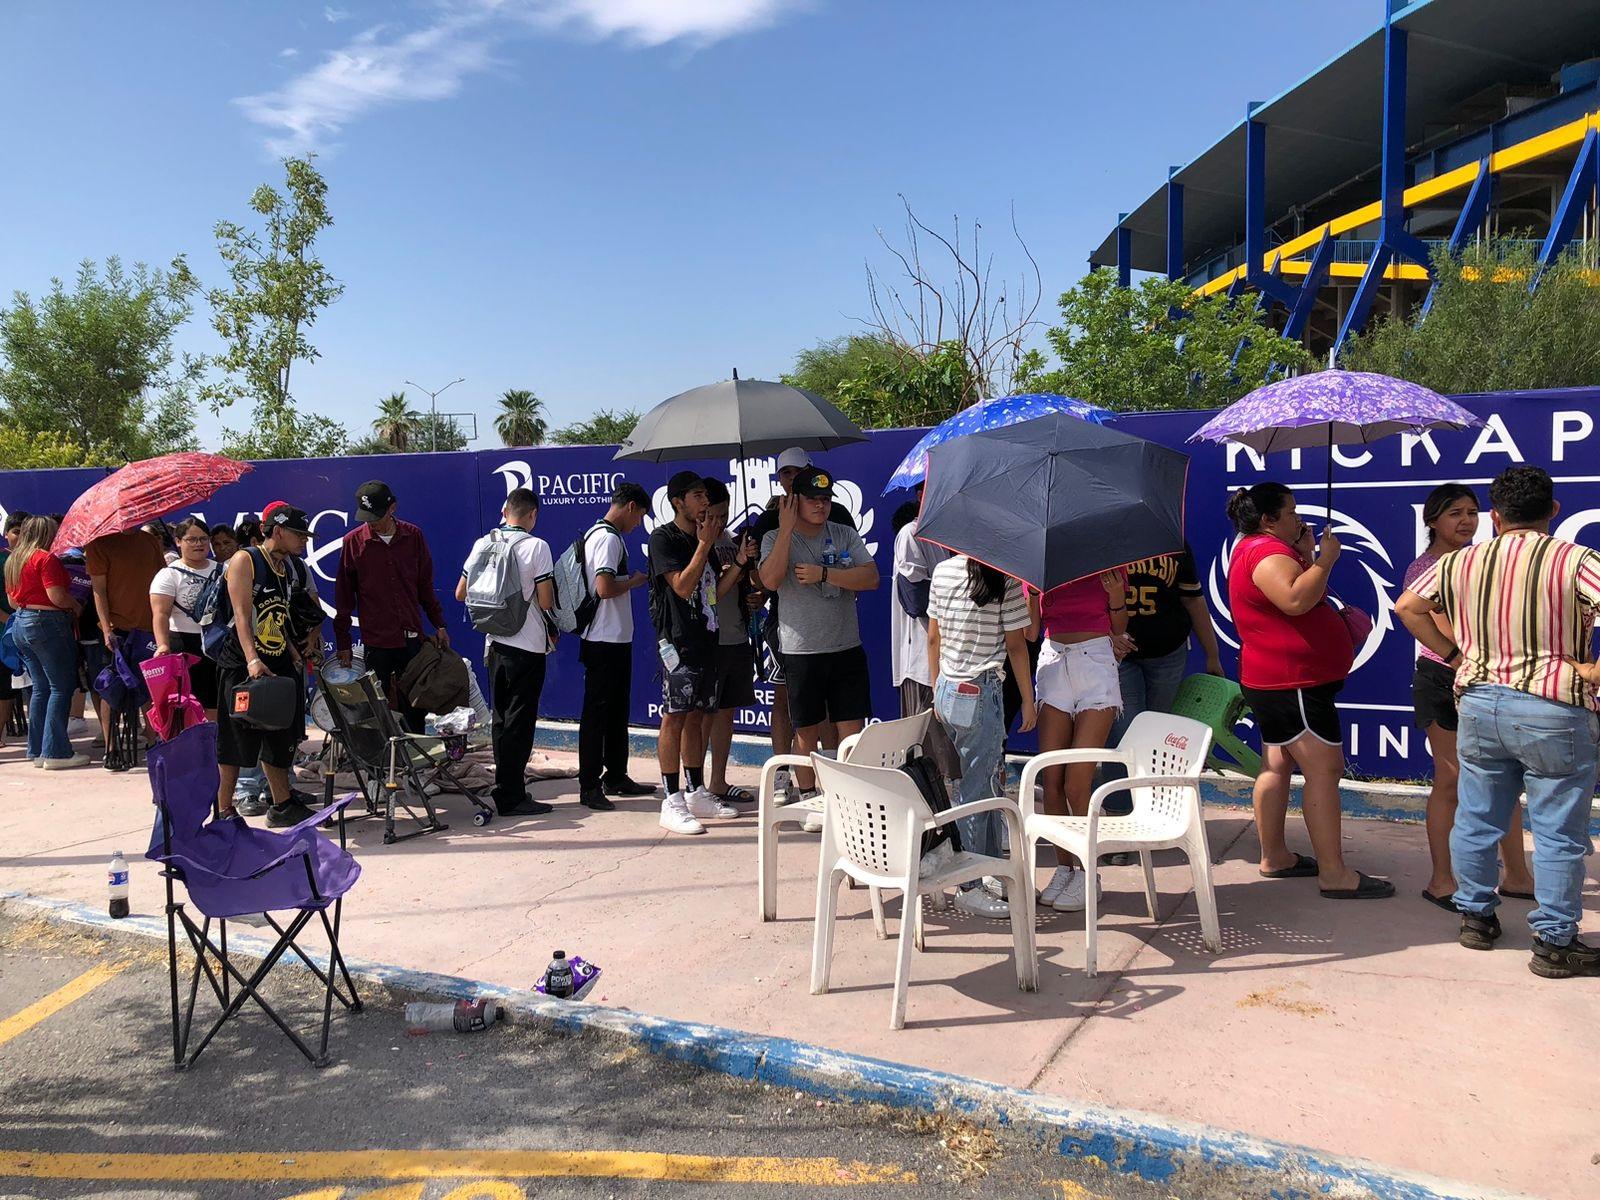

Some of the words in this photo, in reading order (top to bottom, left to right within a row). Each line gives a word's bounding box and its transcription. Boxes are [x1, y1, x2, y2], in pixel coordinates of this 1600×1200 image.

[538, 472, 625, 496] PACIFIC
[542, 497, 576, 505] LUXURY
[578, 496, 612, 504] CLOTHI
[1125, 586, 1157, 615] 25
